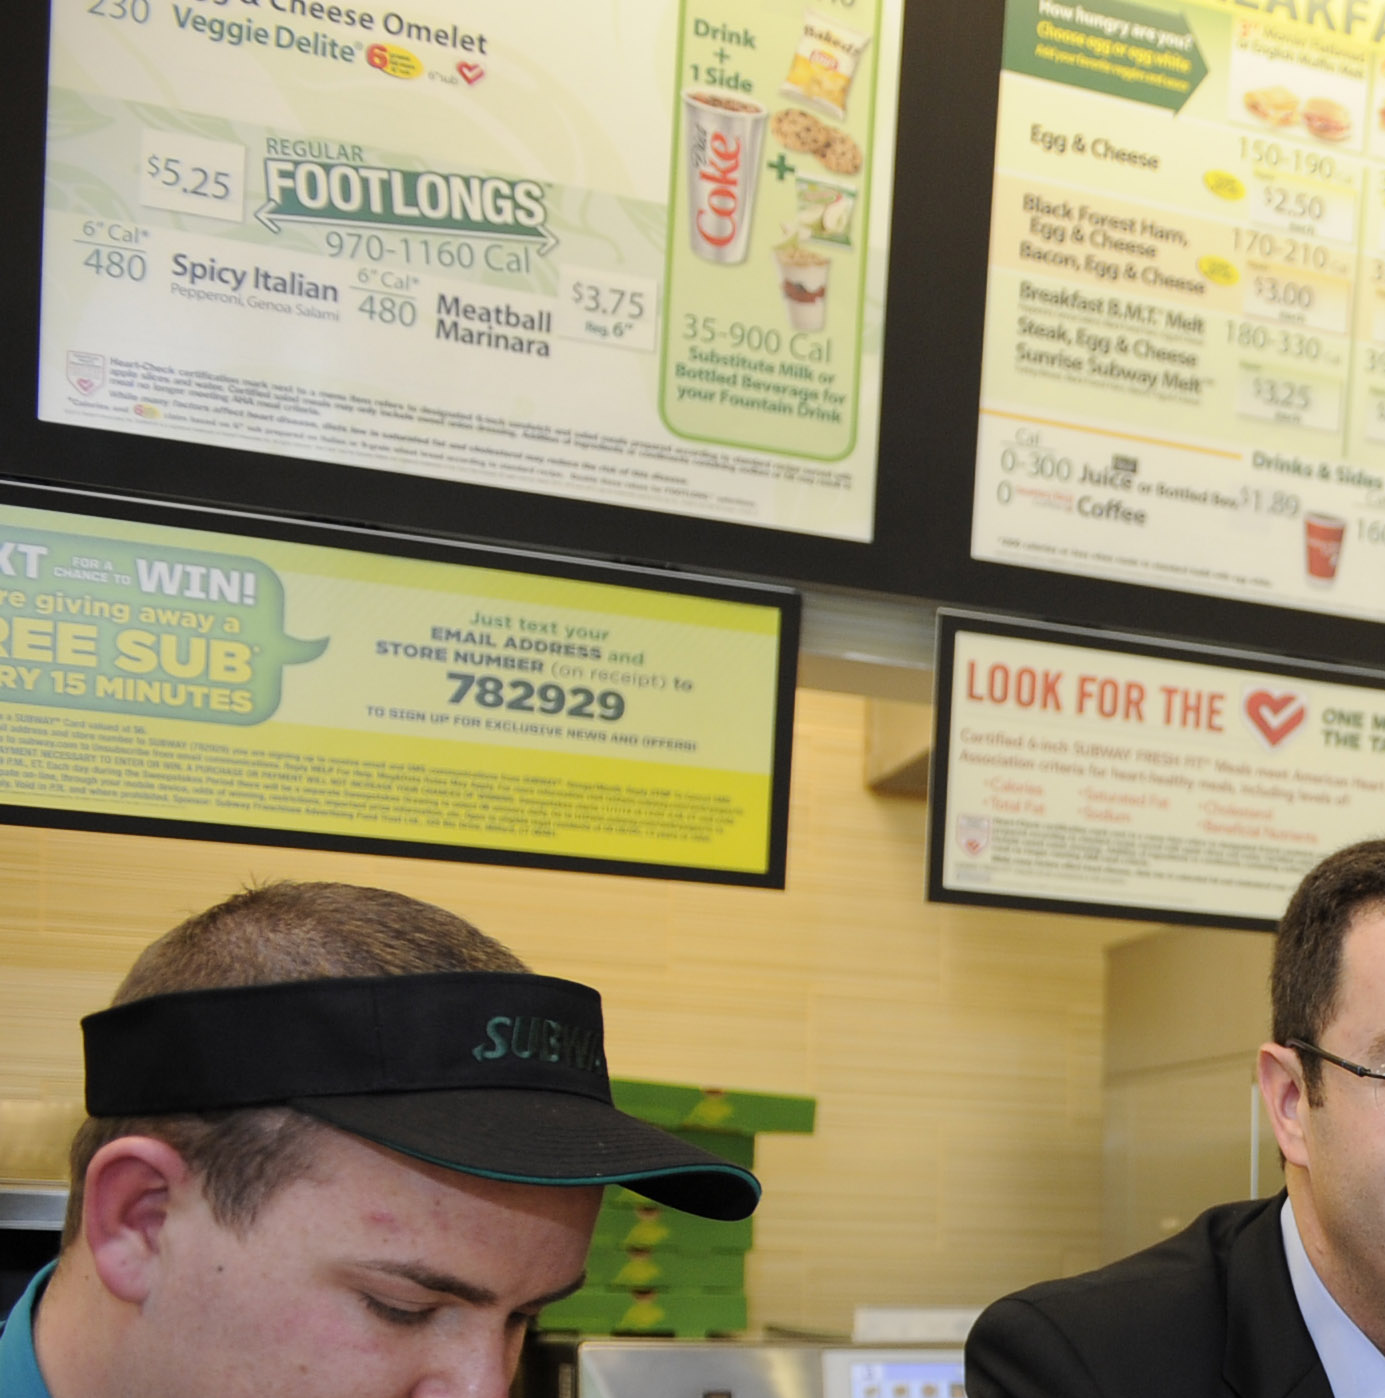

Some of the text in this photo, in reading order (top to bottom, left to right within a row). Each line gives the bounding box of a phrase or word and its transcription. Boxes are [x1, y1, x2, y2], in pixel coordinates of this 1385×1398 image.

[172, 5, 269, 46] Veggie
[383, 14, 488, 55] Omelet
[694, 18, 757, 49] Drink
[1075, 5, 1194, 50] hungry you?
[706, 66, 753, 92] Side
[266, 138, 363, 162] REGULAR
[1029, 123, 1160, 171] Egg Cheese
[147, 154, 231, 200] $5.25
[266, 160, 546, 227] FOOTLONGS
[696, 131, 741, 248] Coke
[1022, 191, 1073, 221] Black
[1077, 205, 1136, 232] Forest
[325, 231, 530, 274] 970-1160 Cal
[1028, 214, 1159, 259] Egg Cheese
[83, 250, 147, 283] 480
[171, 254, 340, 304] Spicy Italian
[1018, 240, 1208, 296] Bacon, Egg Cheese
[248, 294, 341, 323] Genoa Salami
[358, 295, 417, 328] 480
[437, 293, 553, 334] Meatball
[572, 281, 645, 321] $3.75
[1018, 279, 1206, 334] Breakfast Melt
[435, 319, 551, 359] Marinara
[683, 313, 833, 364] 35-900 Cal
[1075, 326, 1112, 355] Egg
[1132, 339, 1200, 370] Cheese
[675, 363, 819, 402] Bottled Beverage
[688, 346, 814, 381] Substitute Milk
[1015, 341, 1159, 389] Sunrise Subway
[719, 389, 843, 424] Fountain Drink
[1077, 462, 1134, 492] Juice
[1251, 450, 1385, 490] Drinks Sides
[1076, 495, 1148, 527] Coffee
[53, 567, 132, 587] CHANCE TO
[72, 556, 101, 571] FOR
[136, 557, 257, 607] WIN!
[35, 591, 241, 634] giving away a
[468, 611, 611, 643] Just text your
[375, 640, 448, 663] STORE
[454, 650, 545, 674] NUMBER
[431, 626, 646, 667] EMAIL ADDRESS and
[50, 670, 254, 715] 15 MINUTES
[446, 671, 627, 722] 782929
[966, 659, 1228, 733] LOOK FOR THE
[1322, 708, 1365, 728] ONE
[1322, 729, 1363, 750] THE
